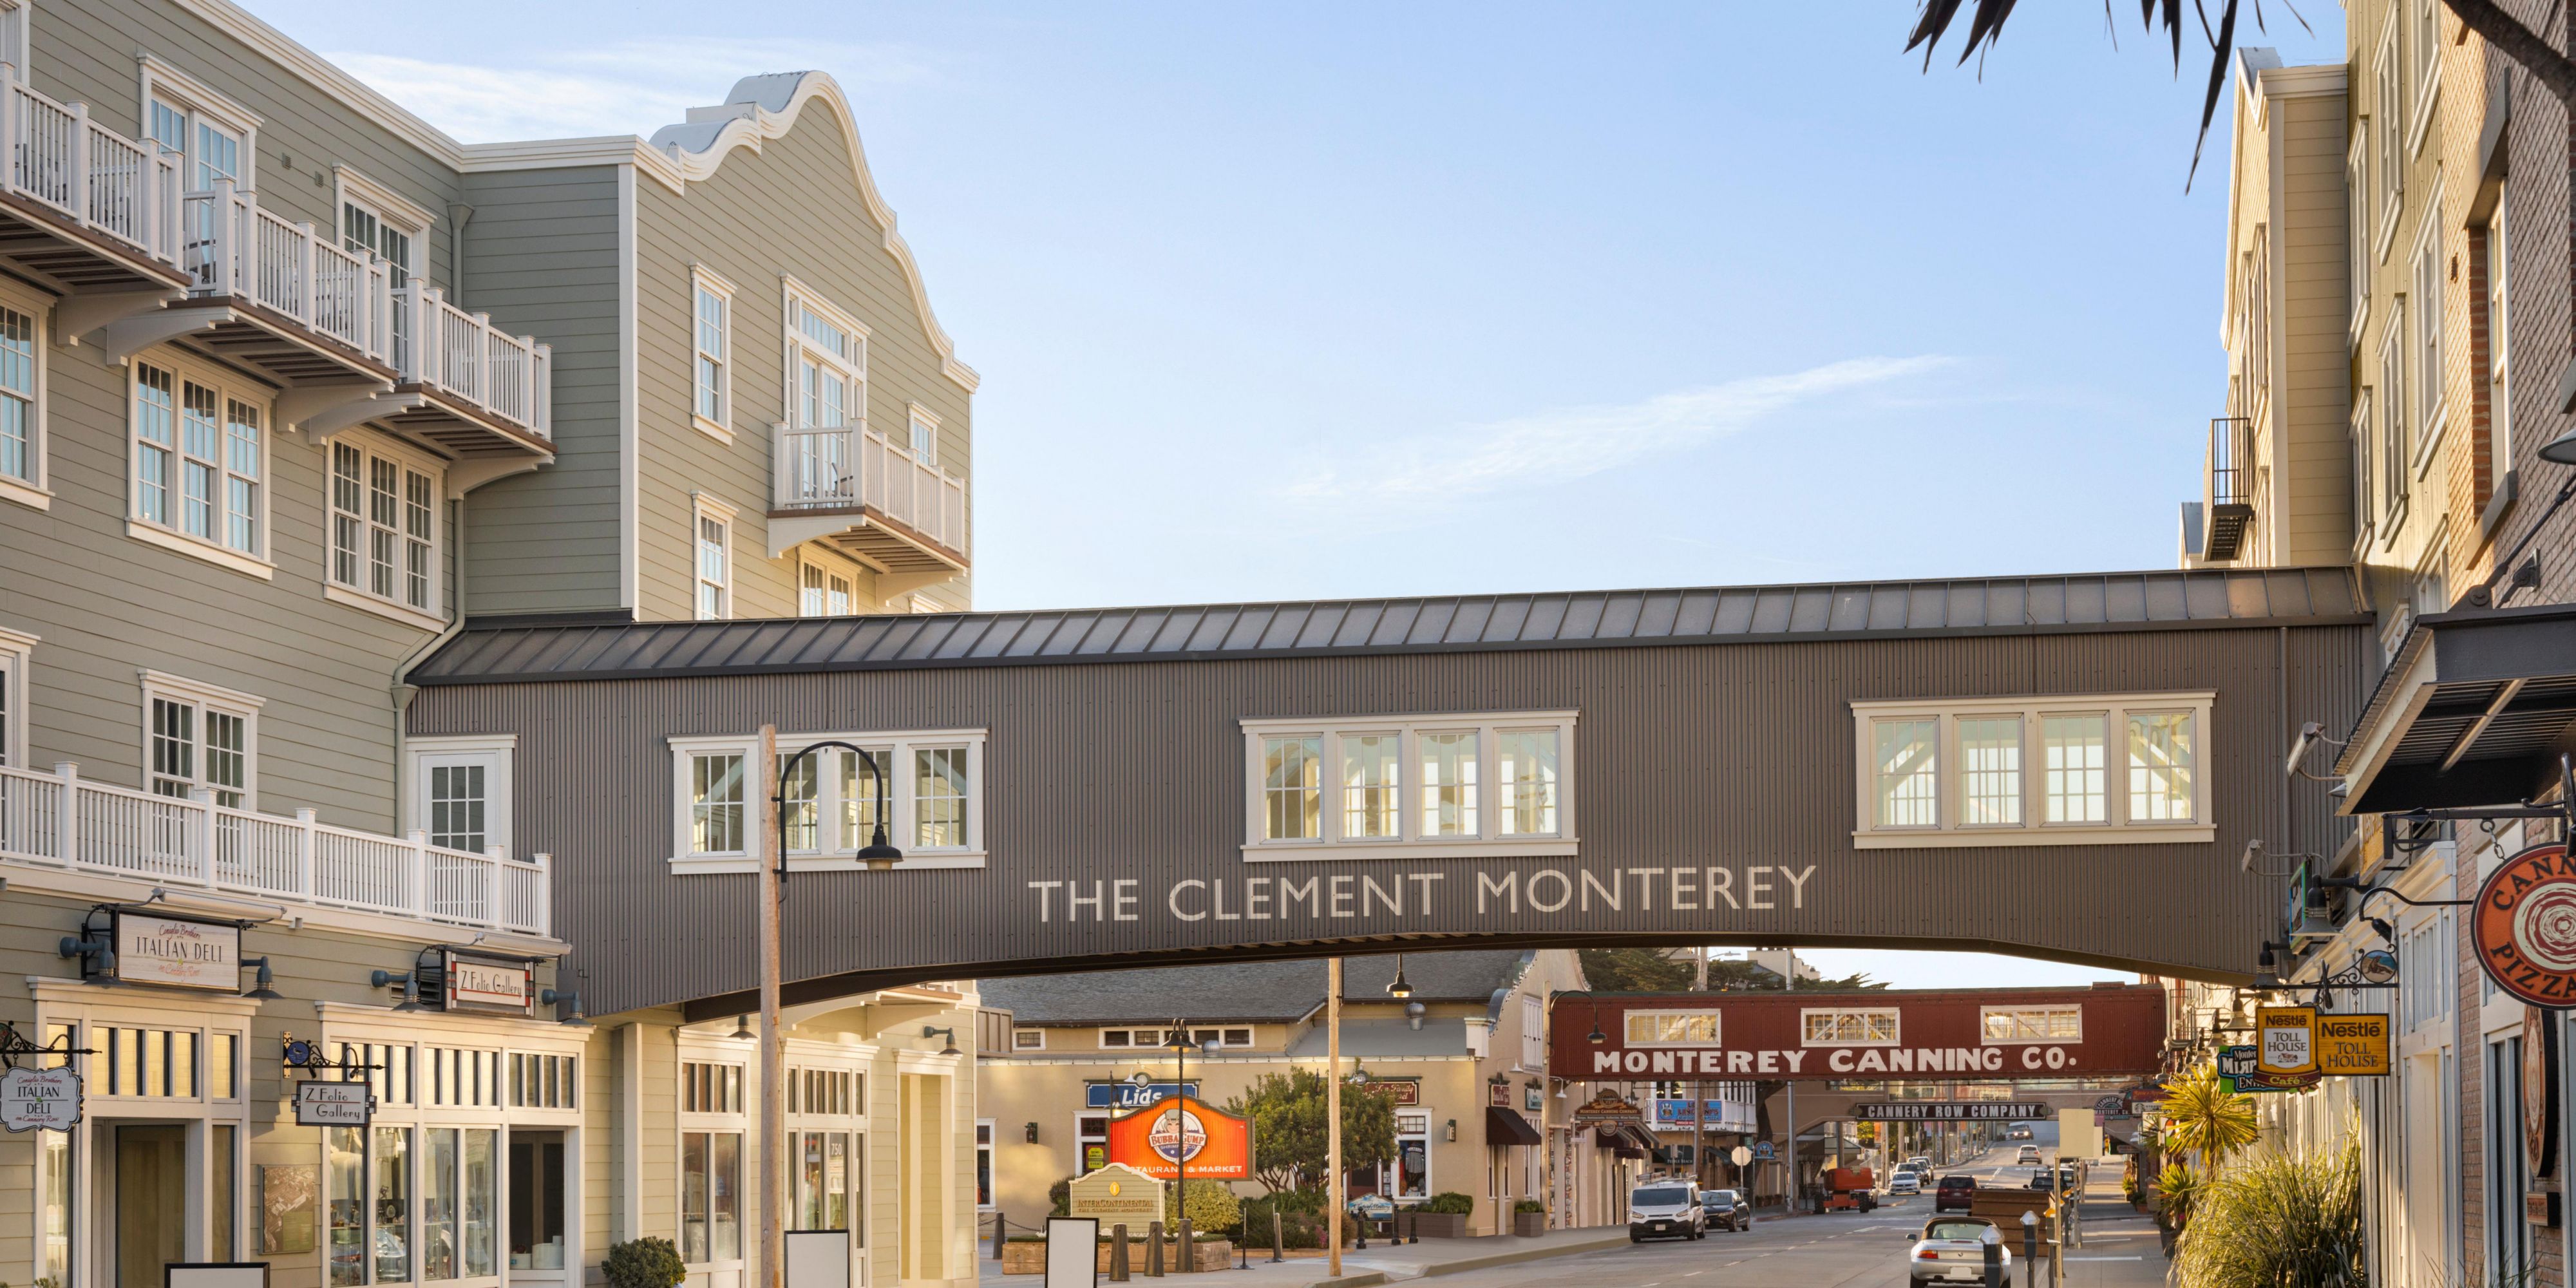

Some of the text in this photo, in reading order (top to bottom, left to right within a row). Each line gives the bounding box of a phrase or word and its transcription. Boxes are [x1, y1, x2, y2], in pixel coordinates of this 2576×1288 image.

[2493, 855, 2576, 911] CANN
[1028, 865, 1816, 922] THE CLEMENT MONTEREY
[159, 923, 201, 940] Coniglio Brothers
[137, 936, 222, 962] ITALIAN DELI
[461, 970, 522, 998] Z Folio Gallery
[2266, 1015, 2307, 1026] Nestlé
[2322, 1022, 2381, 1037] Nestlé
[2273, 1032, 2301, 1042] TOLL
[2268, 1042, 2307, 1052] HOUSE
[2334, 1041, 2371, 1054] TOLL
[1594, 1046, 2077, 1073] MONTEREY CANNING CO.
[2234, 1050, 2257, 1060] Monter
[2326, 1054, 2379, 1068] HOUSE
[17, 1075, 62, 1086] Coniglio Brothers
[2269, 1076, 2300, 1085] Café
[18, 1086, 59, 1097] ITALIAN
[305, 1088, 348, 1101] Z Folio
[1122, 1089, 1162, 1104] Lids
[26, 1103, 50, 1113] DELI
[316, 1104, 360, 1121] Gallery
[1868, 1104, 2035, 1118] CANNERY ROW COMPANY
[23, 1115, 45, 1124] Cannery
[1151, 1135, 1179, 1145] BUBBA
[831, 1143, 842, 1155] 750
